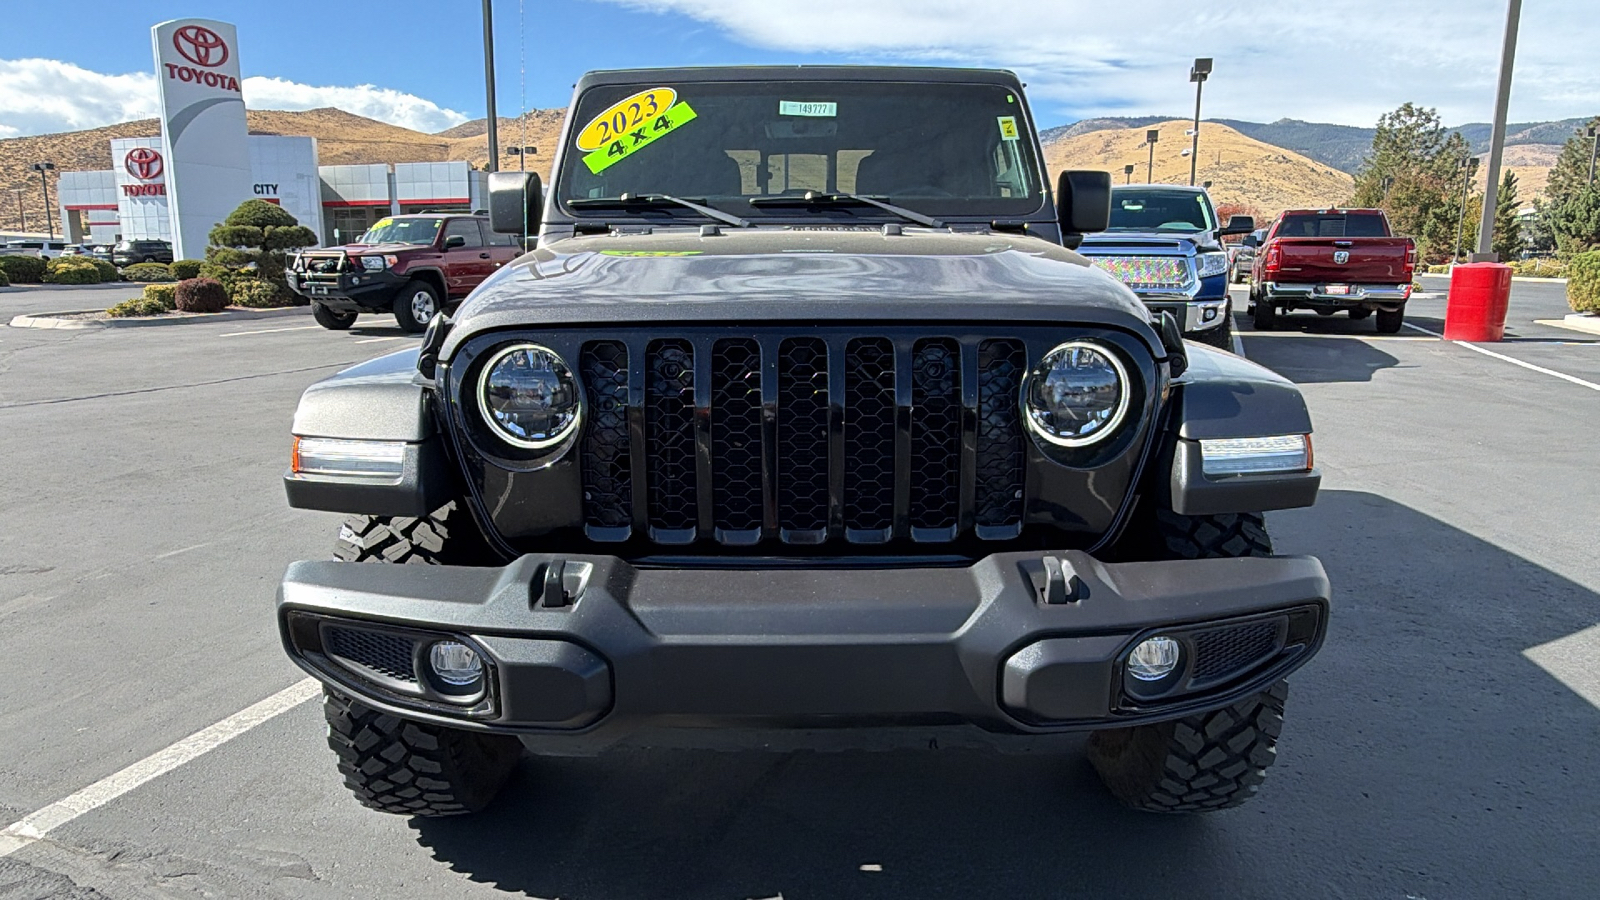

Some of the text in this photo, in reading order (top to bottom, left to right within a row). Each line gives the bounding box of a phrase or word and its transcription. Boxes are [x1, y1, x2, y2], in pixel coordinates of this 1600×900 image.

[165, 63, 240, 92] TOYOTA
[799, 104, 828, 114] 149777
[596, 93, 659, 146] 2023
[120, 183, 168, 197] TOYOT
[253, 183, 279, 195] CITY
